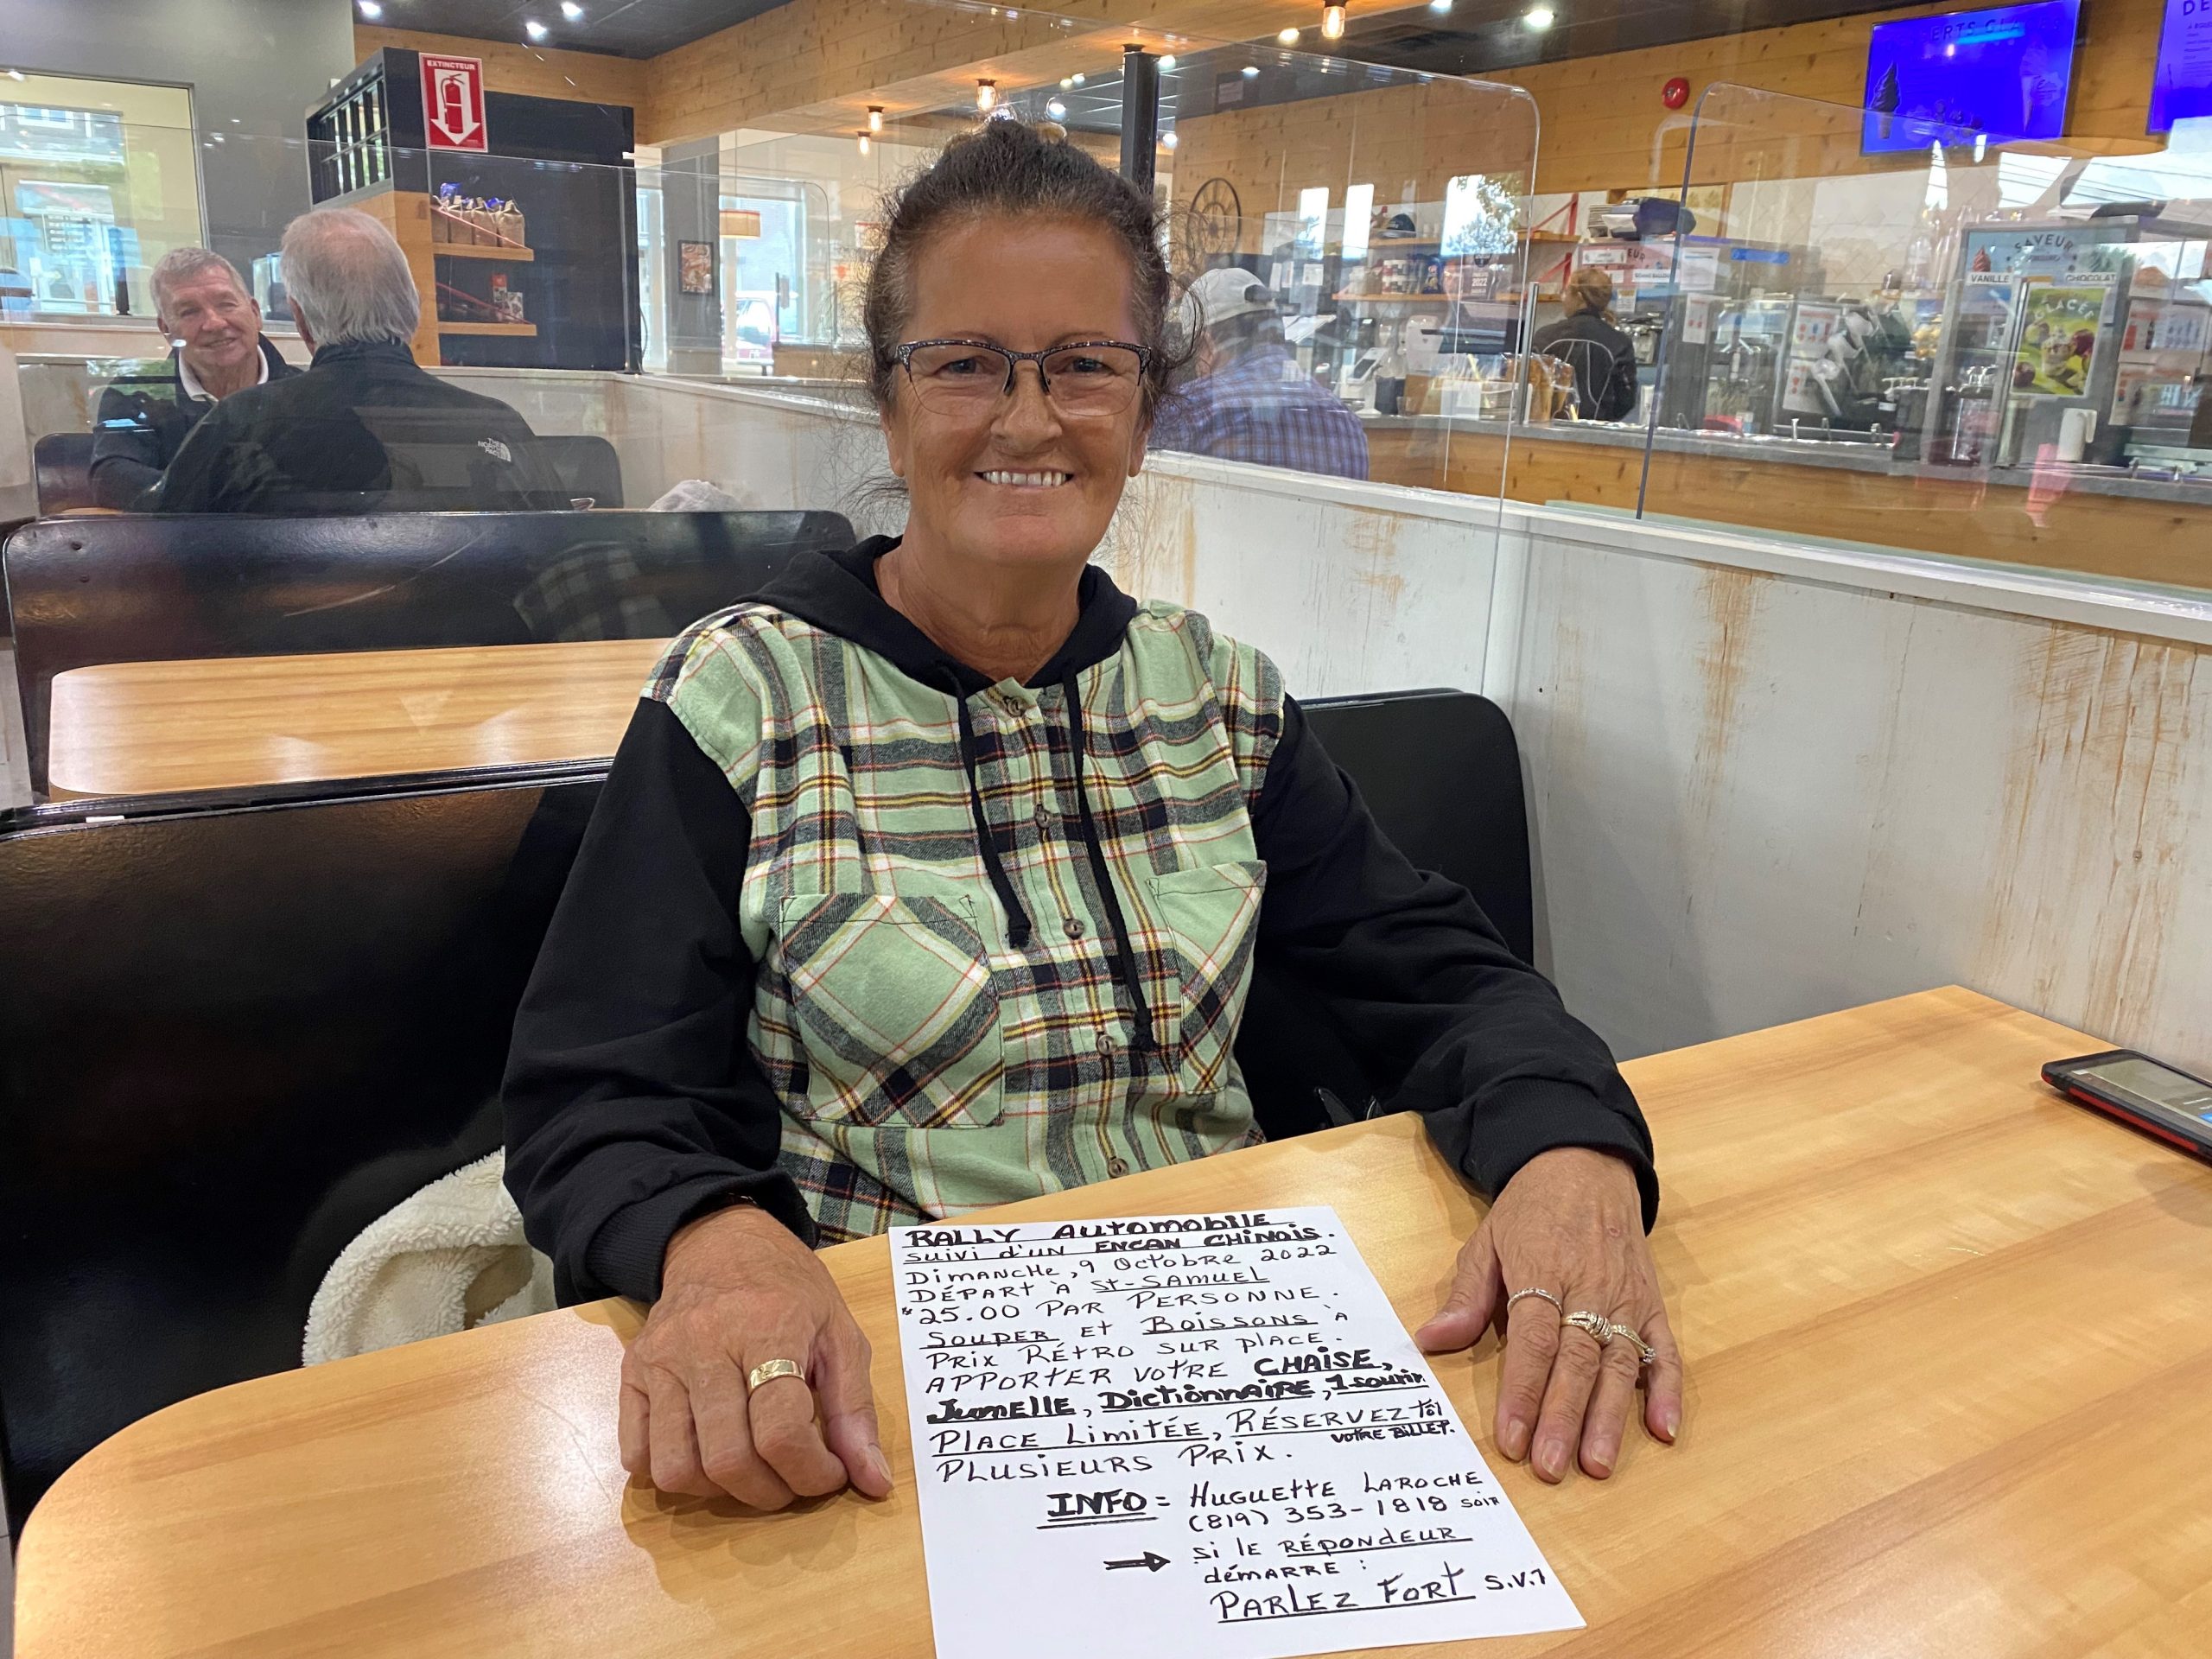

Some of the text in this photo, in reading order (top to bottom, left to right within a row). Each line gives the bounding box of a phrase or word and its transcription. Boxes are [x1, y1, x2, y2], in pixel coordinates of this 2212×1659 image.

[427, 60, 475, 70] EXTINCTEUR
[1971, 274, 2010, 283] VANILLE
[2066, 274, 2117, 283] CHOCOLAT
[905, 1228, 1021, 1247] RALLY
[906, 1245, 979, 1263] suivi
[1094, 1236, 1181, 1254] ENCAN
[1078, 1259, 1096, 1274] 9
[1113, 1252, 1242, 1271] Octobre
[1260, 1244, 1337, 1262] 2022
[908, 1281, 1035, 1303] DÉPART
[1035, 1300, 1105, 1318] PAR
[1017, 1342, 1135, 1364] RÉTRO
[1156, 1338, 1220, 1356] SUR
[925, 1367, 1112, 1394] APPORTER
[1225, 1406, 1410, 1434] RÉSERVEZ
[936, 1453, 1154, 1483] PLUSIEURS
[1363, 1471, 1484, 1493] LAROCHE
[1046, 1489, 1147, 1517] INFO
[1188, 1509, 1269, 1533] (819)
[1283, 1495, 1448, 1523] 353-1818
[1209, 1584, 1359, 1619] PARLEZ
